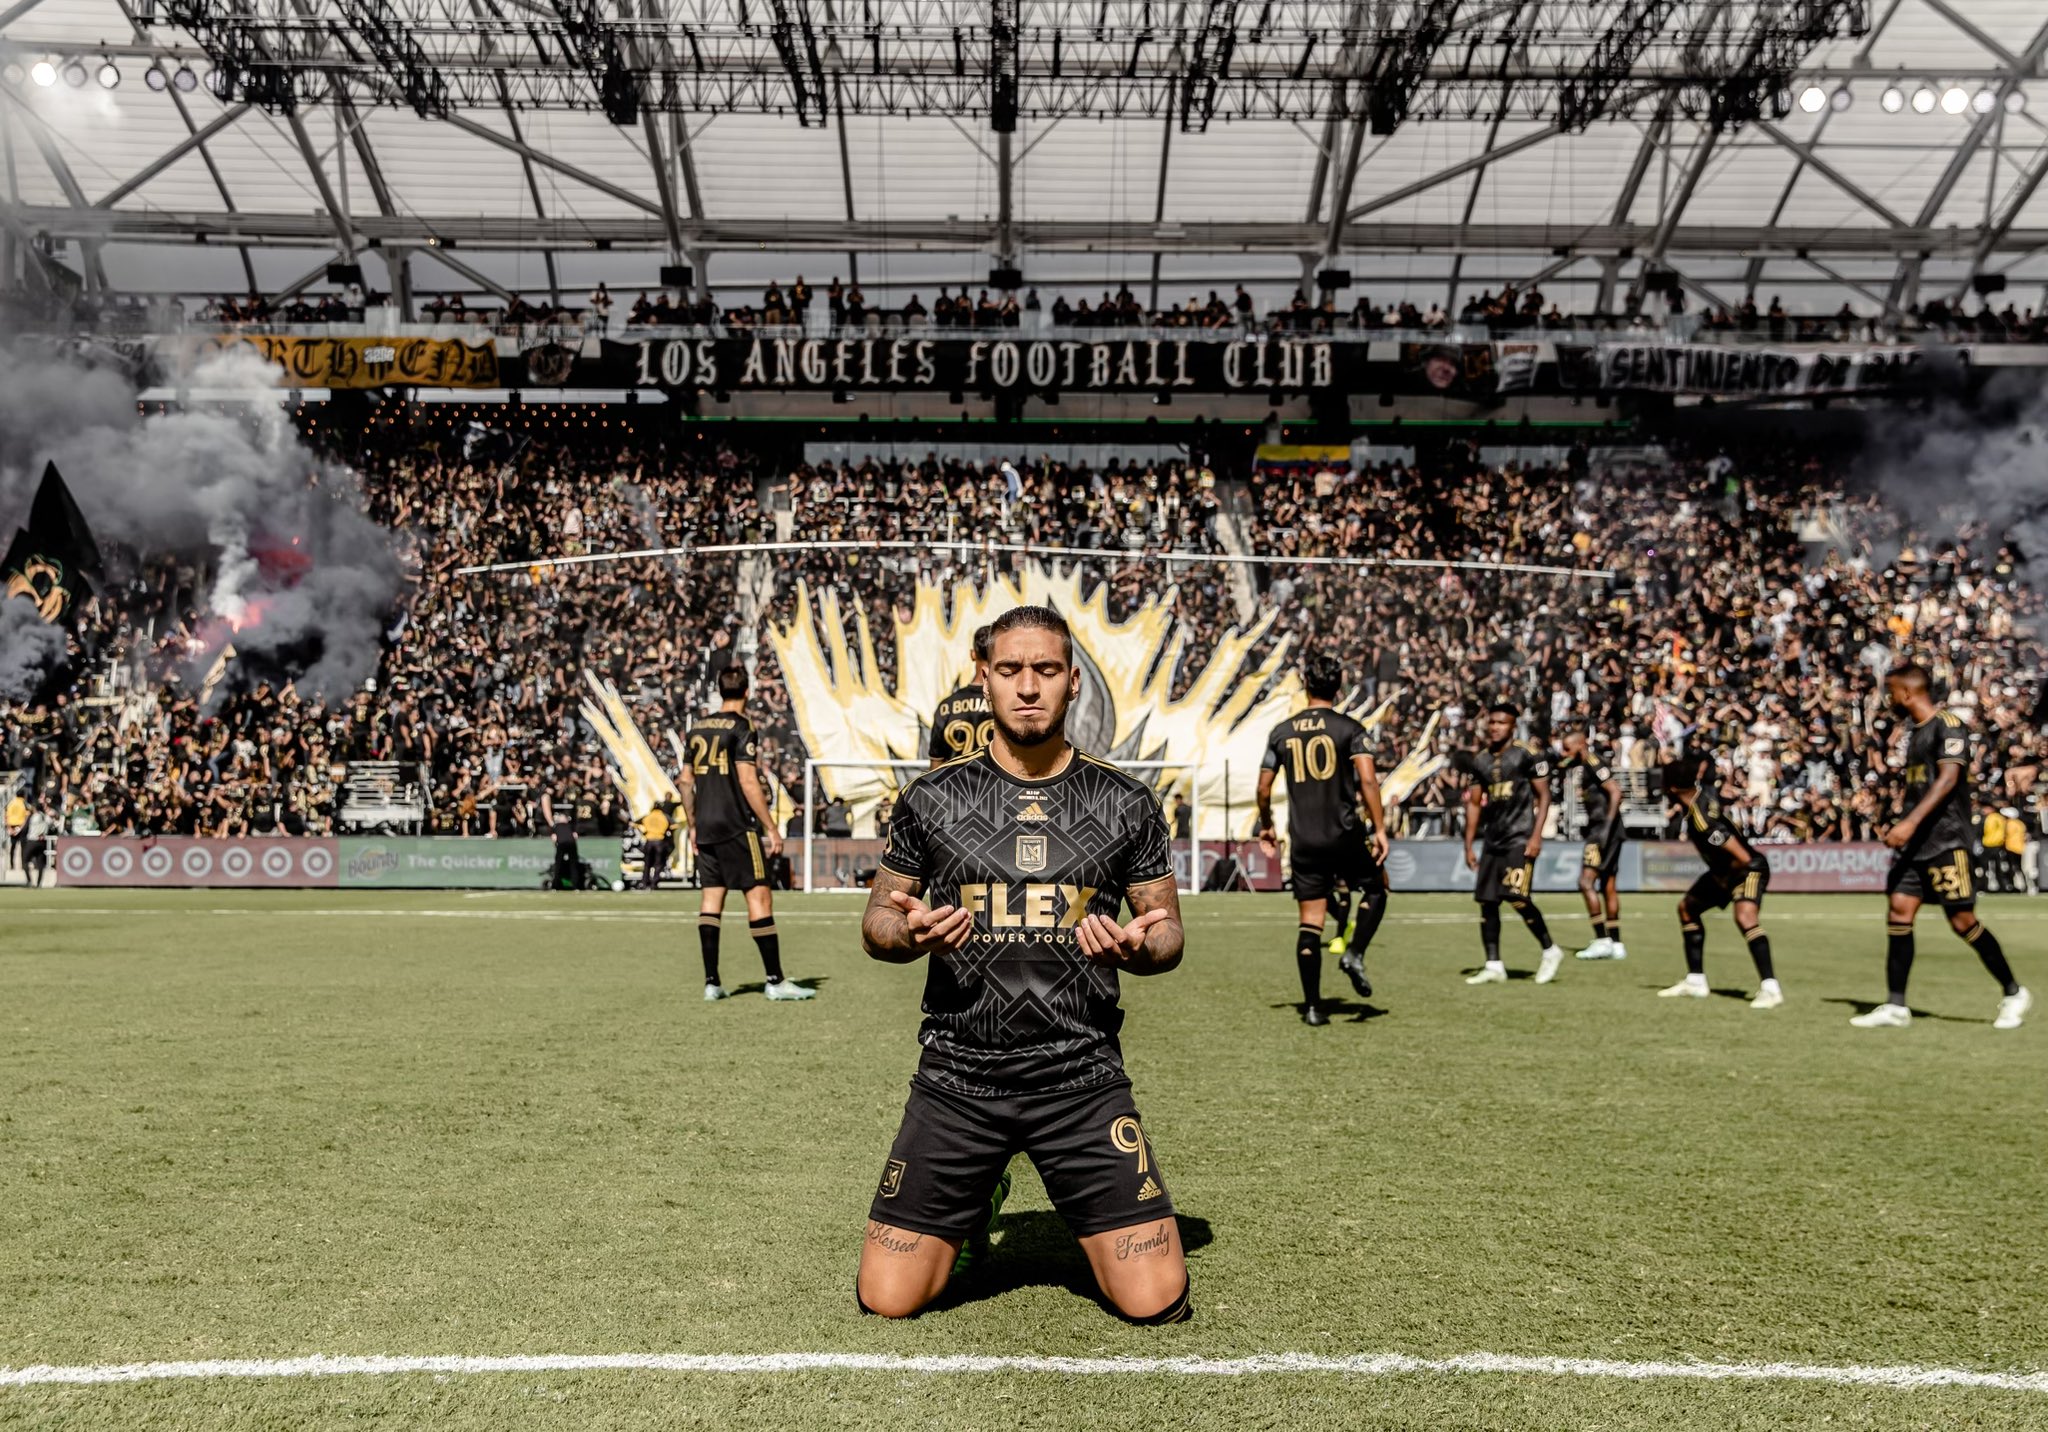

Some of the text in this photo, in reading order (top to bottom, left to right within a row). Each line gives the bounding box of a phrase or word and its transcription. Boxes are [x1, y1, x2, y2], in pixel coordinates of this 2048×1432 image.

[636, 338, 1332, 388] LOS ANGELES FOOTBALL CLUB
[1610, 346, 1800, 393] SENTIMIENTO
[952, 698, 993, 714] BOUA
[1292, 718, 1326, 731] VELA
[689, 735, 729, 775] 24
[1286, 734, 1337, 783] 10
[1016, 813, 1049, 821] adidas
[348, 851, 551, 877] Bounty The Quicker Picke
[1550, 850, 1581, 883] 5
[1767, 849, 1894, 873] BODYARMO
[1502, 866, 1524, 888] 20
[1928, 865, 1960, 892] 23
[960, 883, 1098, 928] FLEX
[973, 933, 1079, 944] POWER TOOL
[1110, 1116, 1148, 1174] 9
[1137, 1188, 1162, 1201] adidas
[869, 1221, 922, 1252] Blessed
[1114, 1224, 1170, 1261] Family
